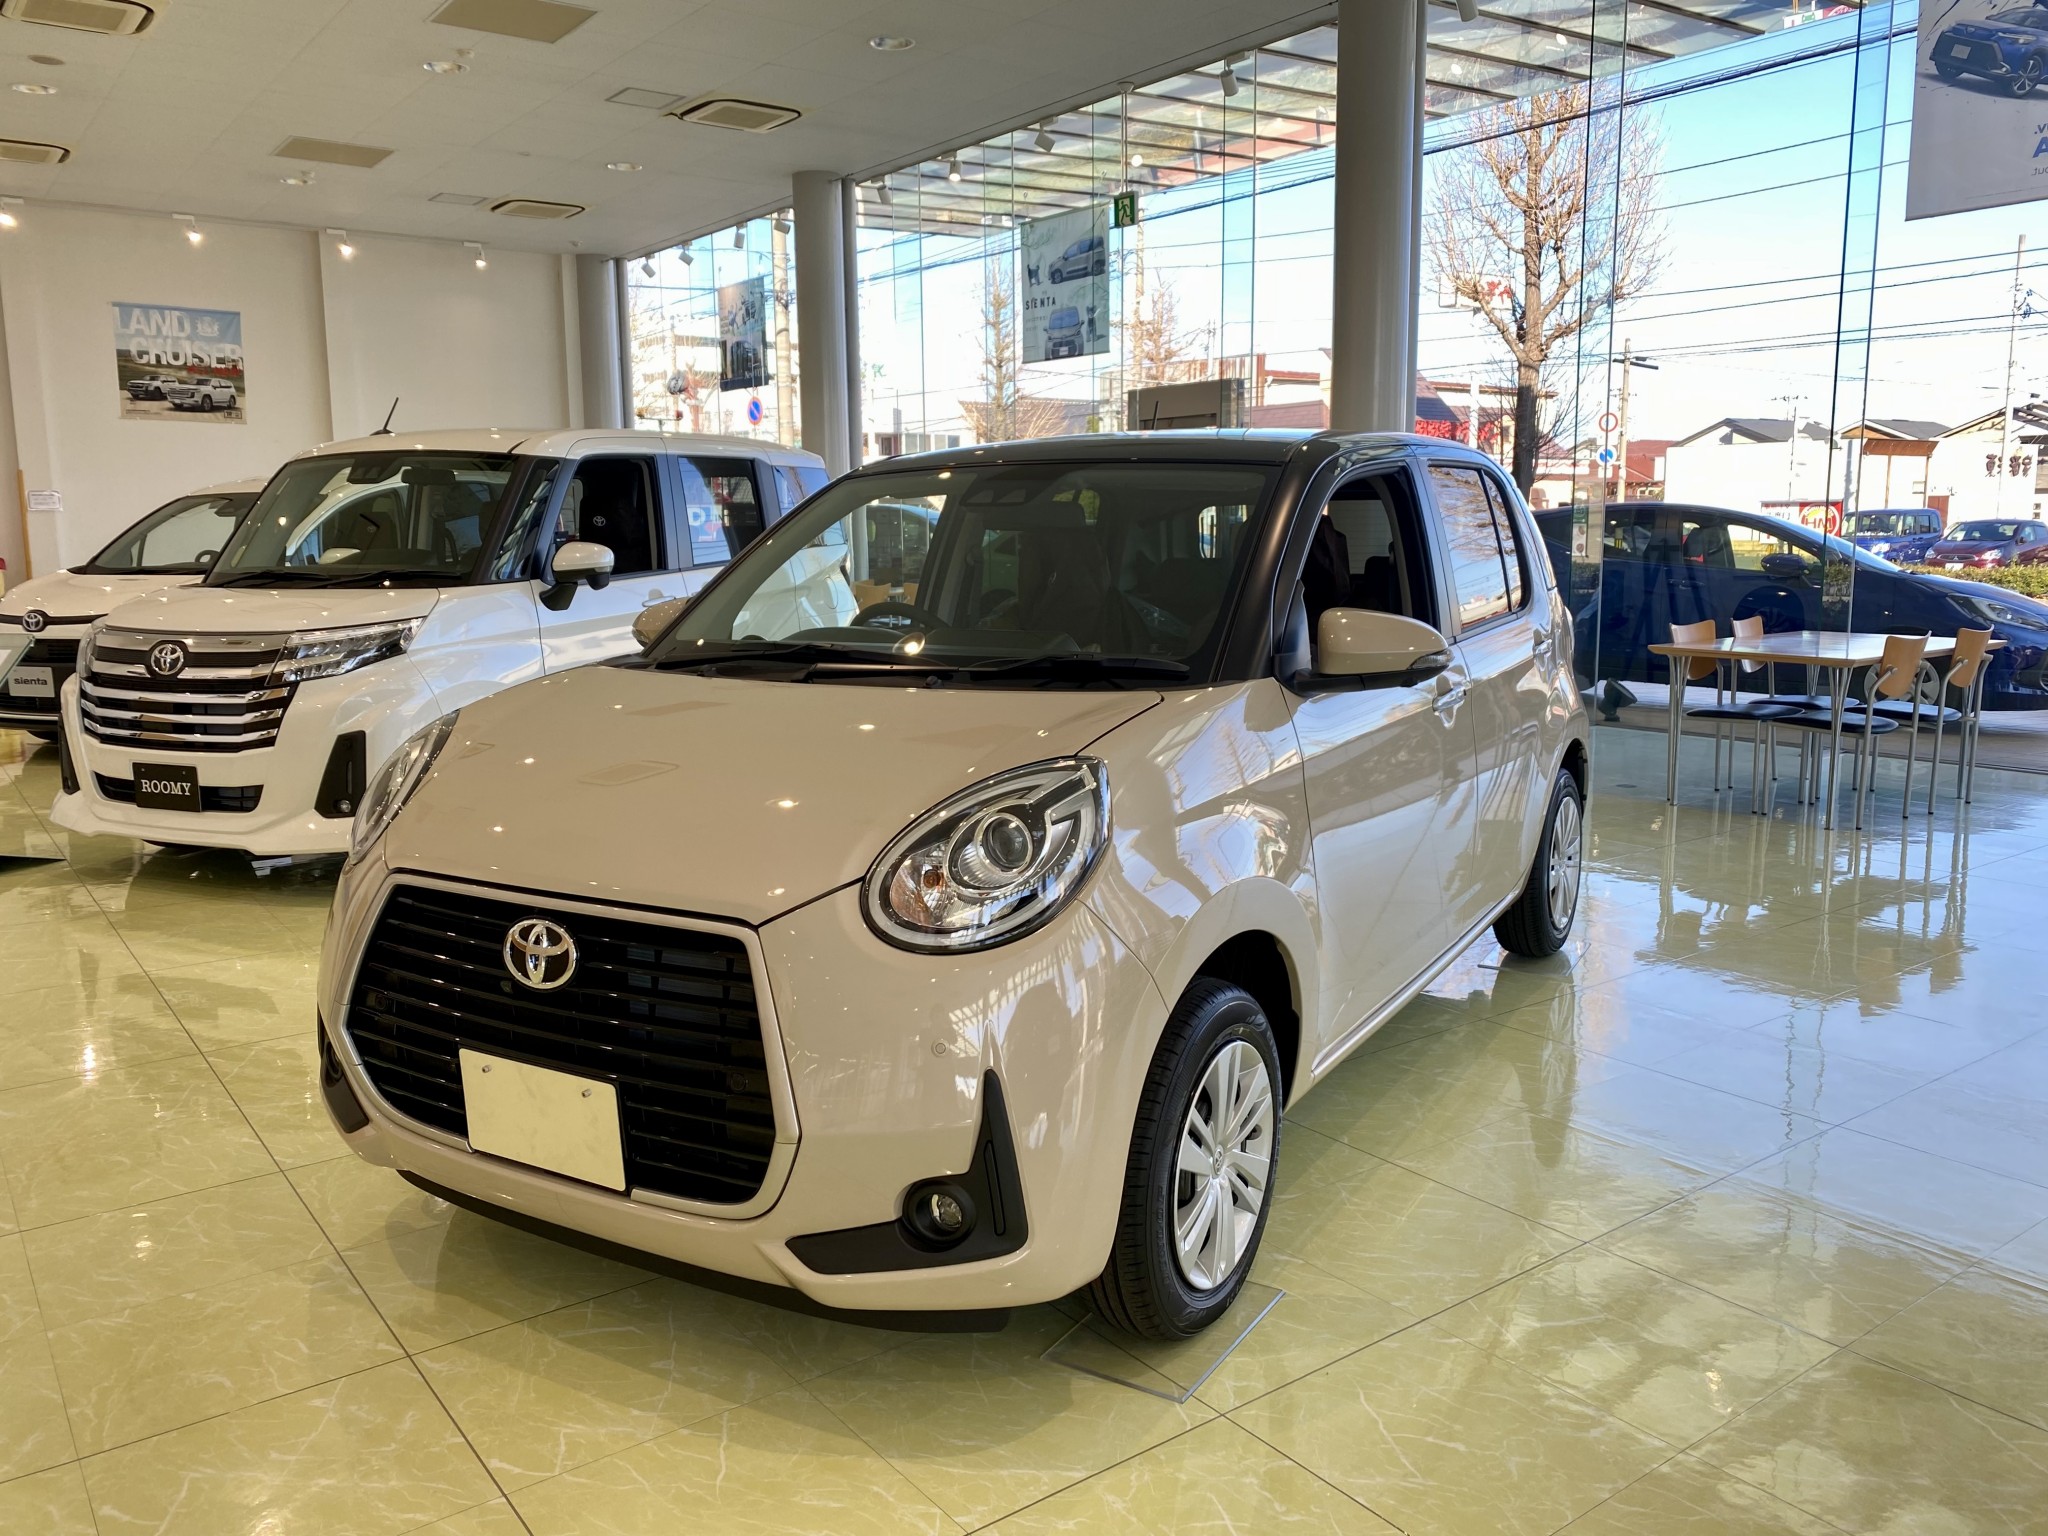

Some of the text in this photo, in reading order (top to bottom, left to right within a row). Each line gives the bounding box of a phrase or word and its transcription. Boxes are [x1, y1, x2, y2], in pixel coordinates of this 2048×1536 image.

[1025, 296, 1056, 311] SIENTA
[112, 306, 191, 338] LAND
[129, 336, 244, 371] CRUISER
[14, 677, 48, 686] sienta
[141, 779, 191, 796] ROOMY
